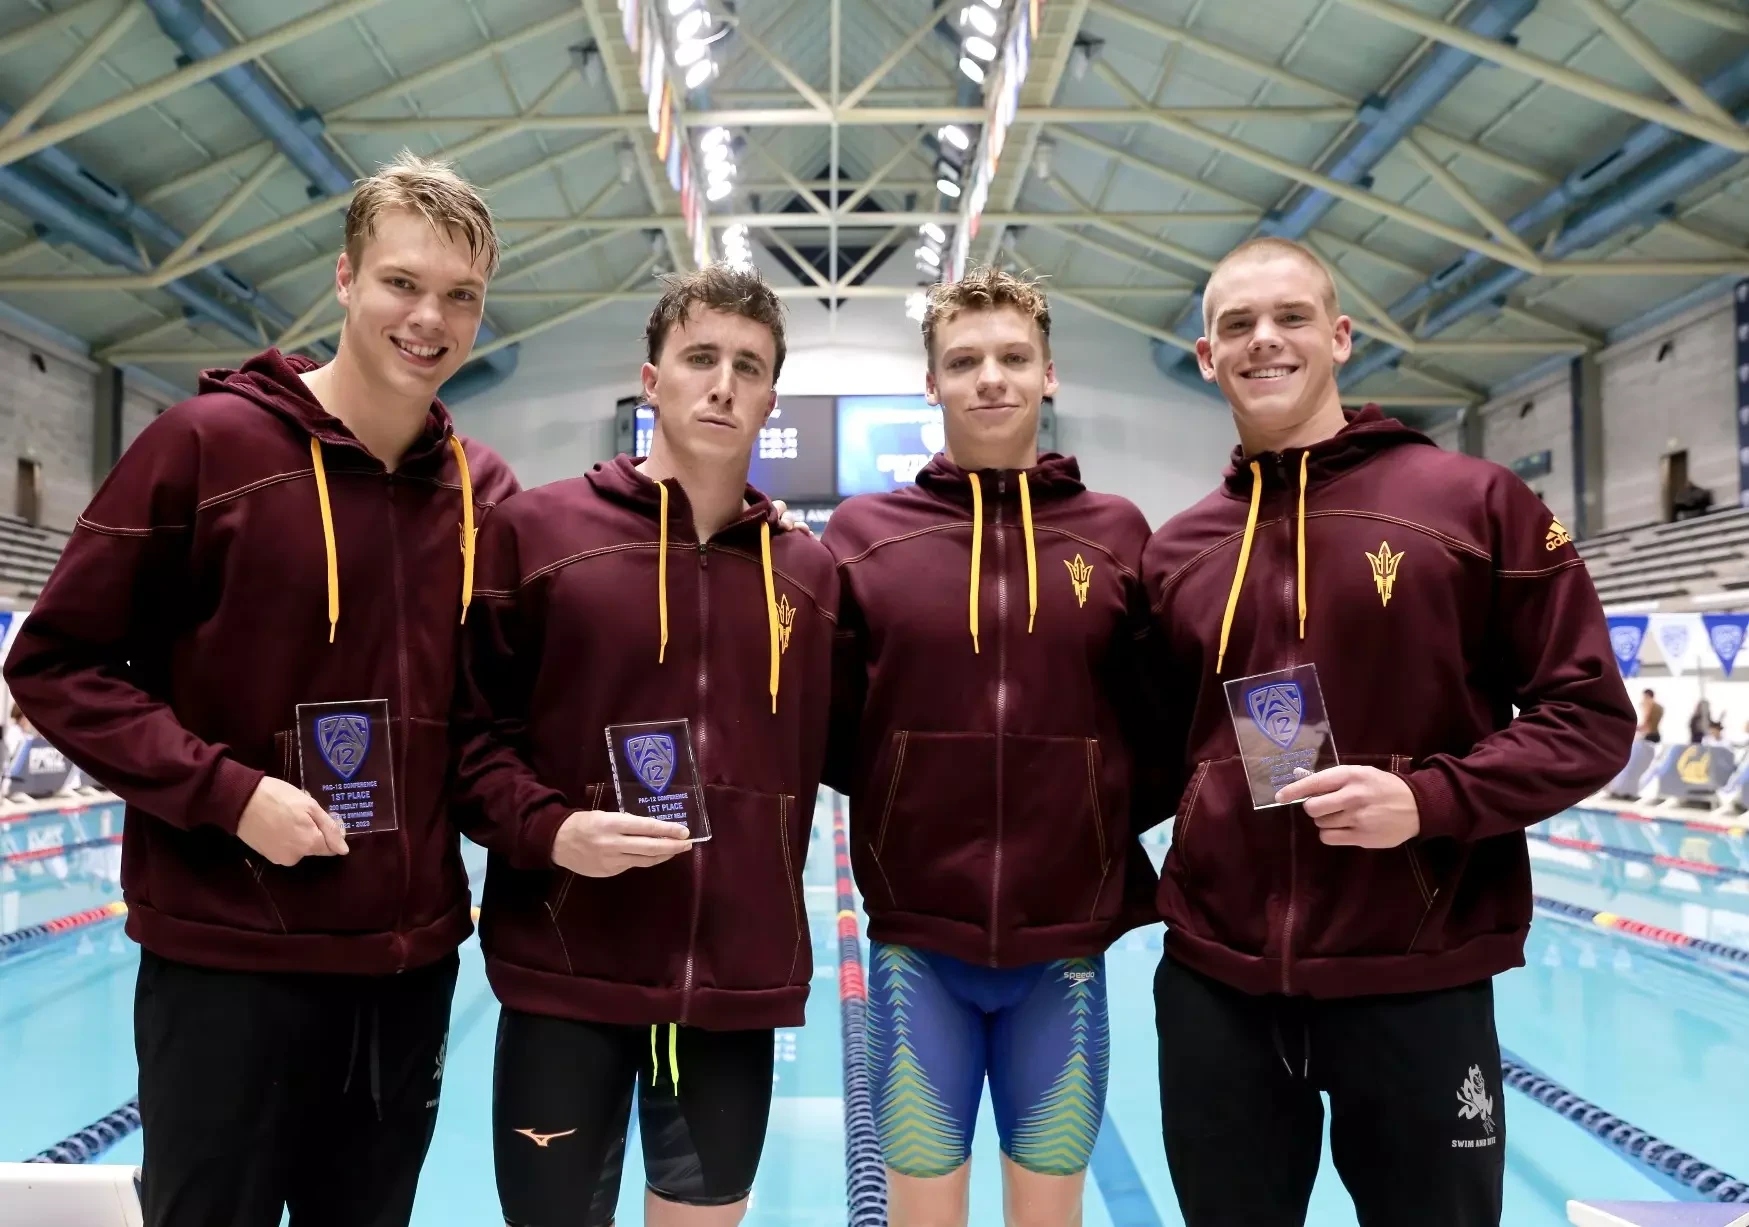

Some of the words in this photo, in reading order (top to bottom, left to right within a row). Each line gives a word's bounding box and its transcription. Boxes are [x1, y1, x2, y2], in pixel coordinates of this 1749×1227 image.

[1272, 717, 1292, 736] 12
[336, 748, 355, 765] 12
[646, 765, 664, 781] 12
[331, 793, 345, 801] 1ST
[347, 791, 370, 800] PLACE
[662, 802, 683, 811] PLACE
[1451, 1140, 1474, 1148] SWIM
